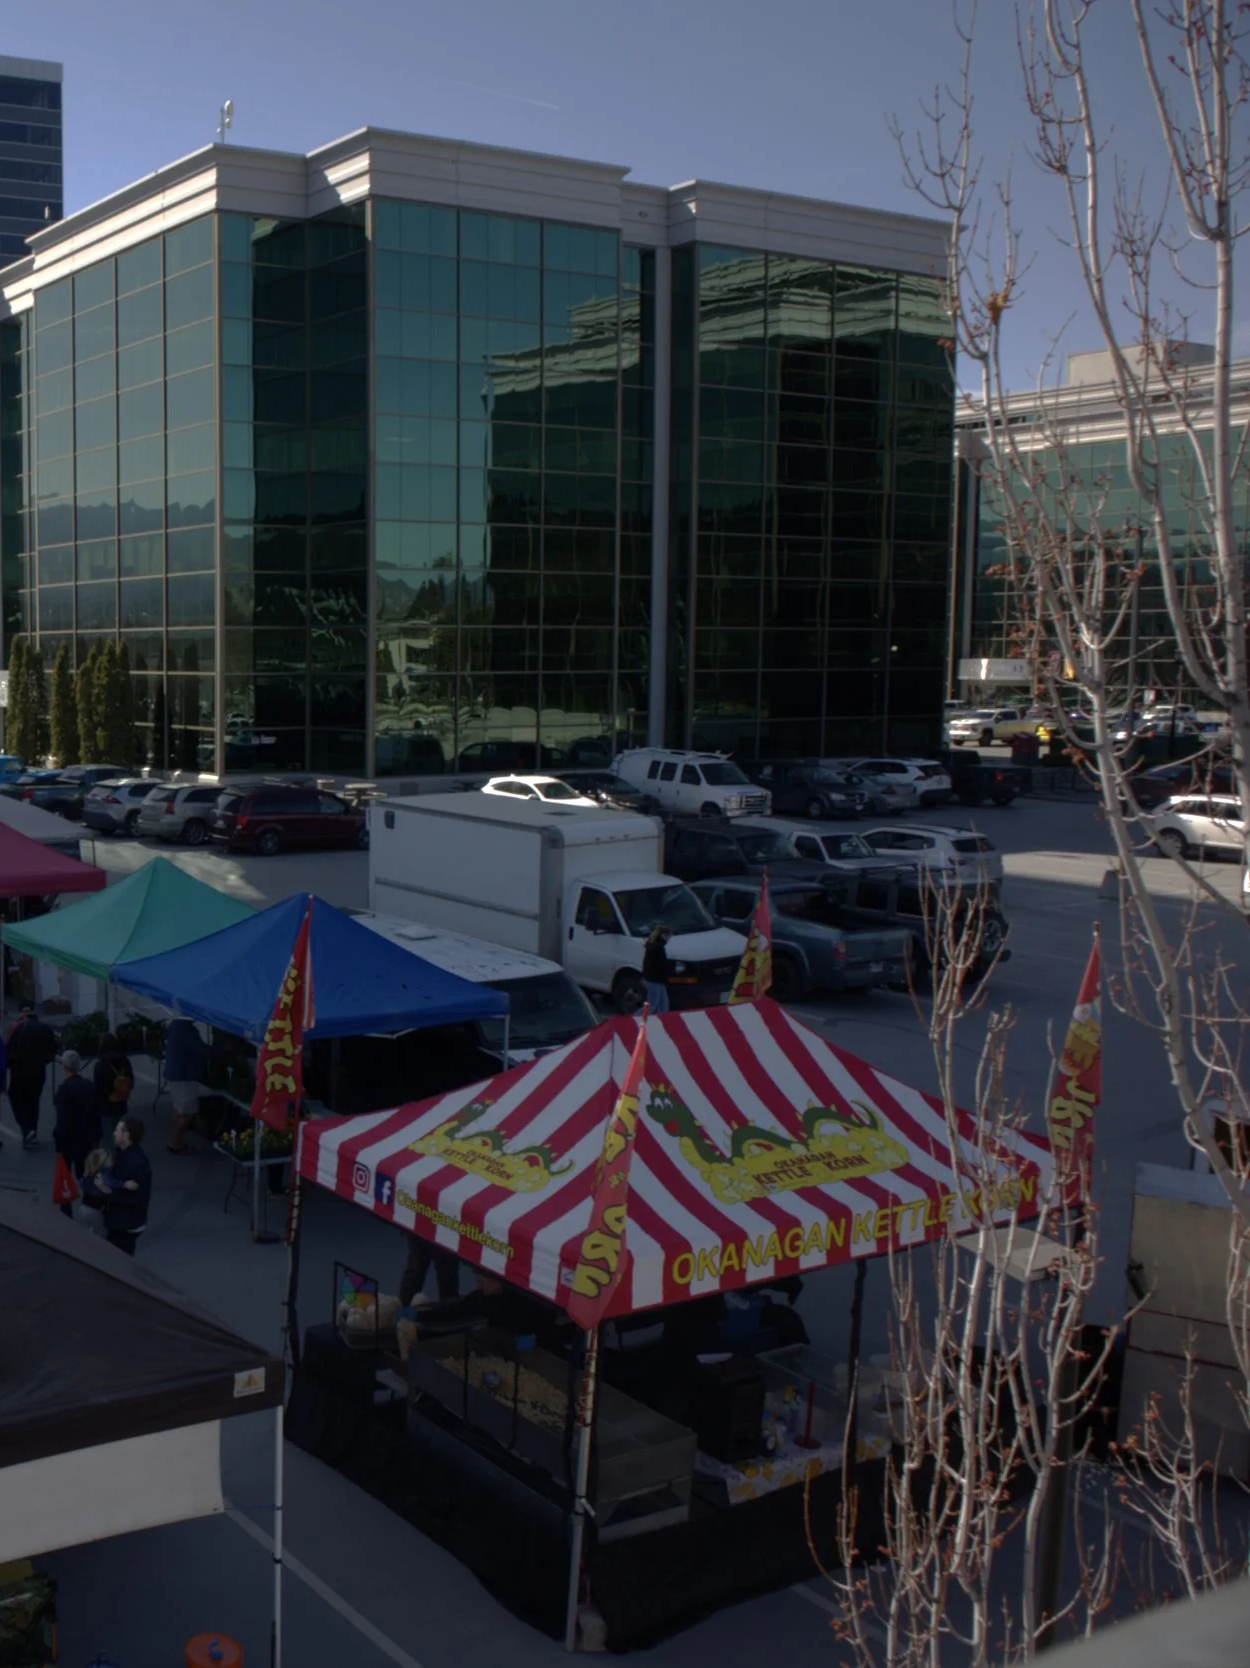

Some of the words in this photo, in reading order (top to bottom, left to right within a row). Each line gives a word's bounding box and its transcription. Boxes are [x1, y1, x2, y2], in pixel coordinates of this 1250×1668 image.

[752, 1166, 813, 1185] KETTLE
[823, 1154, 869, 1171] KORN
[671, 1217, 847, 1286] OKANAGAN
[853, 1193, 958, 1245] KETTLE
